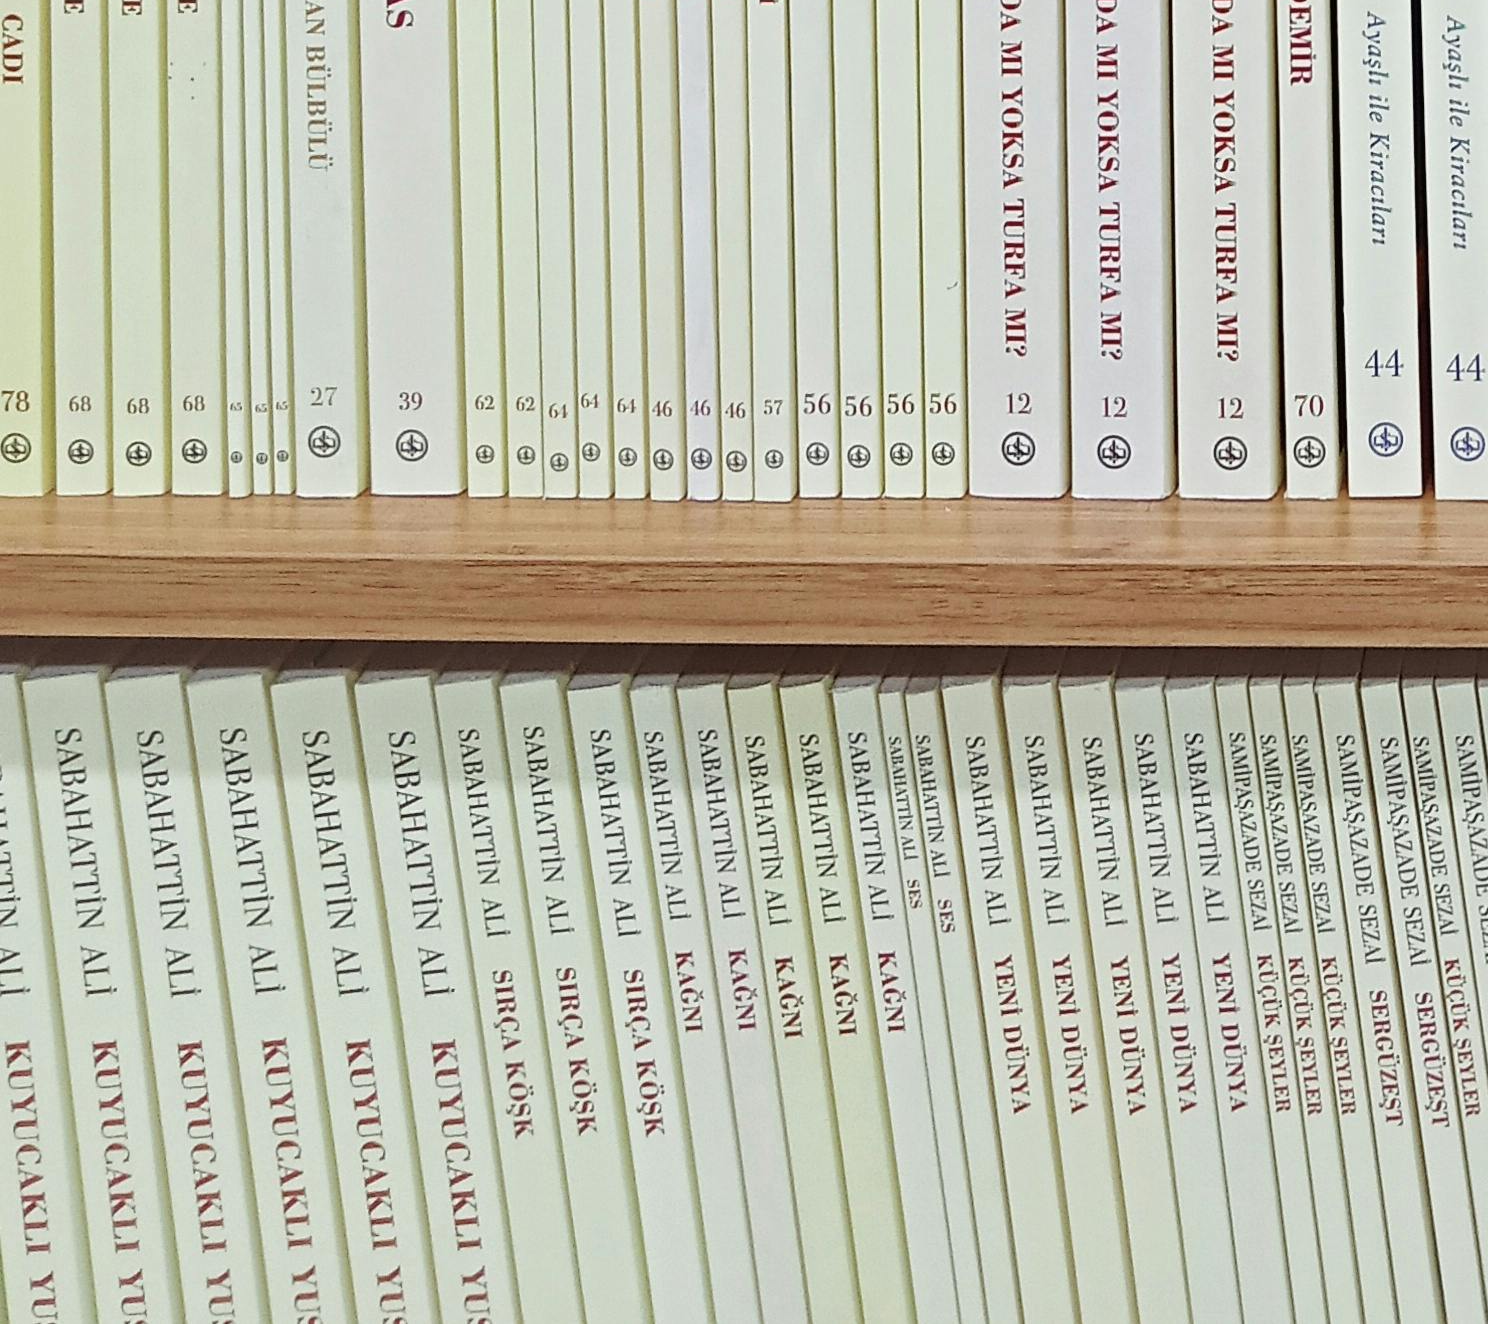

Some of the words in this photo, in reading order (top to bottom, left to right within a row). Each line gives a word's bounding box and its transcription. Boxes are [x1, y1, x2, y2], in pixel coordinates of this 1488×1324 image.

[1095, 42, 1120, 81] MI
[1361, 10, 1390, 87] Ayaşlı
[1096, 87, 1121, 194] YOKSA
[1368, 93, 1391, 124] ile
[1368, 132, 1393, 246] Kiracıları
[1097, 200, 1122, 305] TURFA
[1099, 310, 1124, 361] MI?
[1364, 348, 1405, 378] 44
[182, 394, 206, 413] 68
[398, 391, 424, 412] 39
[1101, 395, 1128, 419] 12
[457, 728, 502, 886] SABAHATTİN
[887, 735, 915, 831] SABAHATTİN
[54, 727, 108, 929] SABAHATTİN
[480, 897, 512, 939] ALİ
[79, 945, 118, 998] ALİ
[1320, 954, 1348, 1032] KÜÇÜK
[491, 969, 523, 1054] SIRÇA
[504, 1060, 535, 1140] KÖŞK
[1328, 1035, 1358, 1118] ŞEYLER
[91, 1039, 141, 1255] KUYUCAKLI
